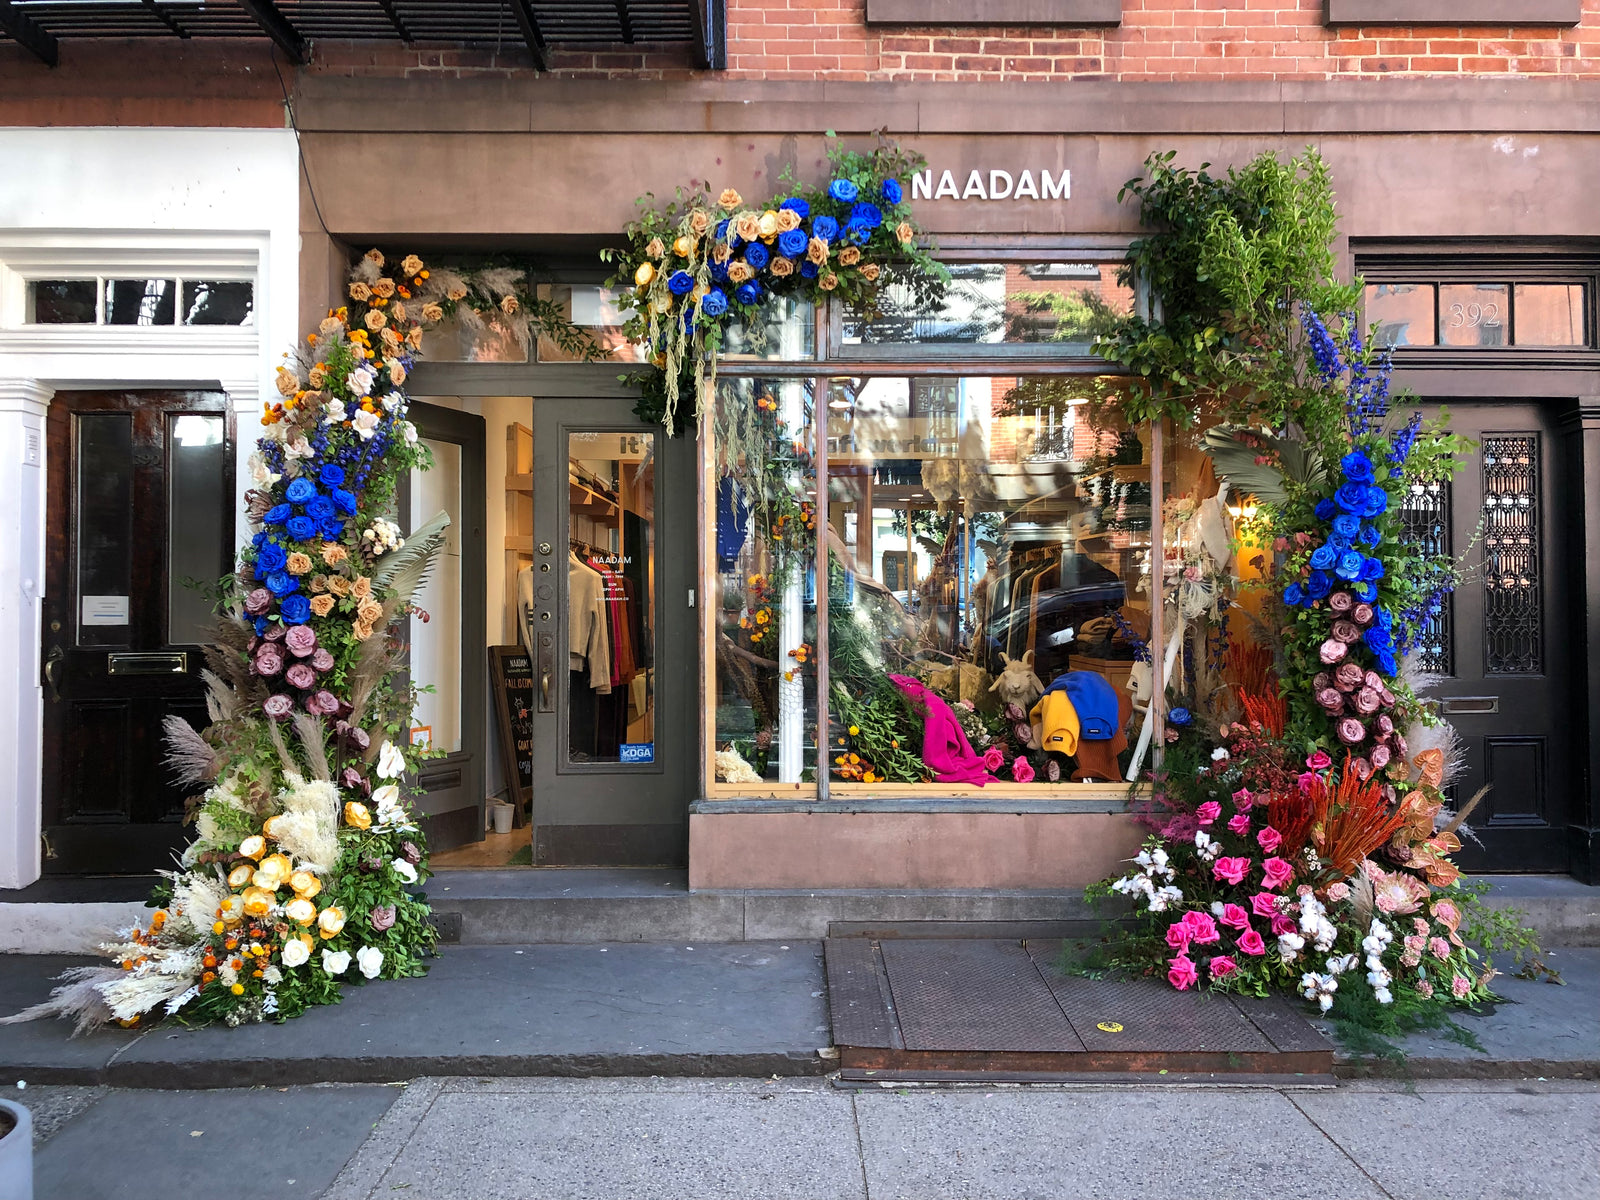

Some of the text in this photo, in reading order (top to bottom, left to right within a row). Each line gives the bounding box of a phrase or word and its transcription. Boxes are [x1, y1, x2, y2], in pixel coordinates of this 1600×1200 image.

[911, 169, 1071, 200] NAADAM
[1449, 302, 1500, 328] 392
[592, 556, 632, 564] NAADAM
